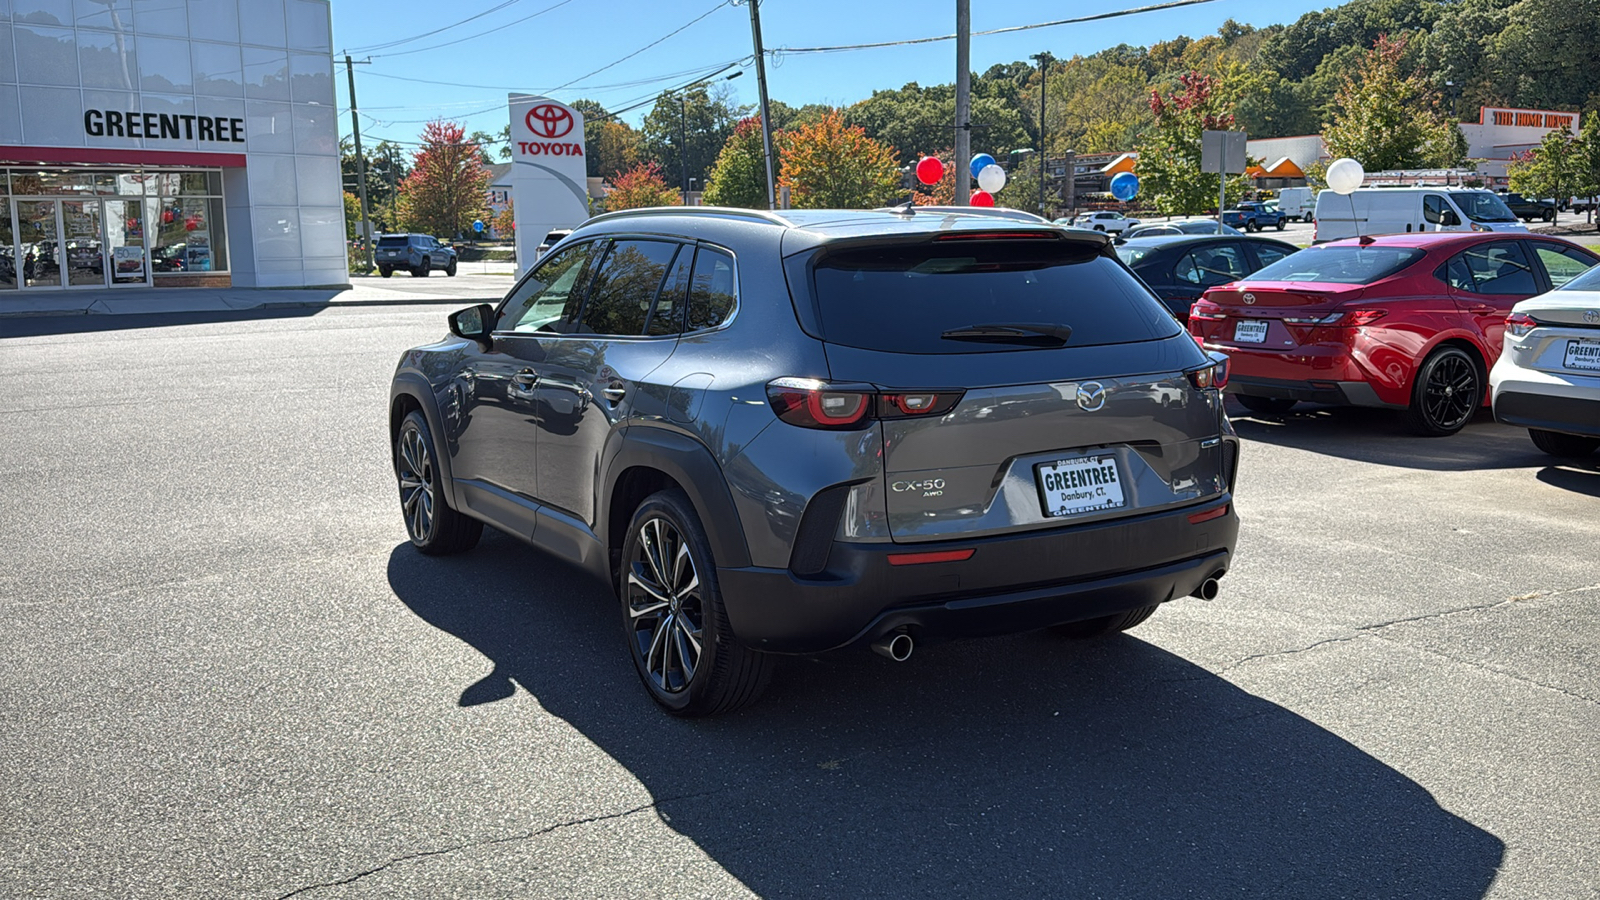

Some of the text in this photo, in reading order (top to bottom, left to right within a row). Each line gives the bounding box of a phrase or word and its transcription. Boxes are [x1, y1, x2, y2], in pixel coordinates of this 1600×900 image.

[84, 109, 245, 143] GREENTREE
[1494, 111, 1573, 128] THE HOME DEPOT
[518, 142, 583, 156] TOYOTA
[1569, 345, 1600, 357] GREENT
[892, 478, 945, 492] CX-50
[1045, 465, 1116, 491] GREENTREE
[1095, 487, 1106, 496] CT.
[1053, 502, 1124, 516] GREENTREE
